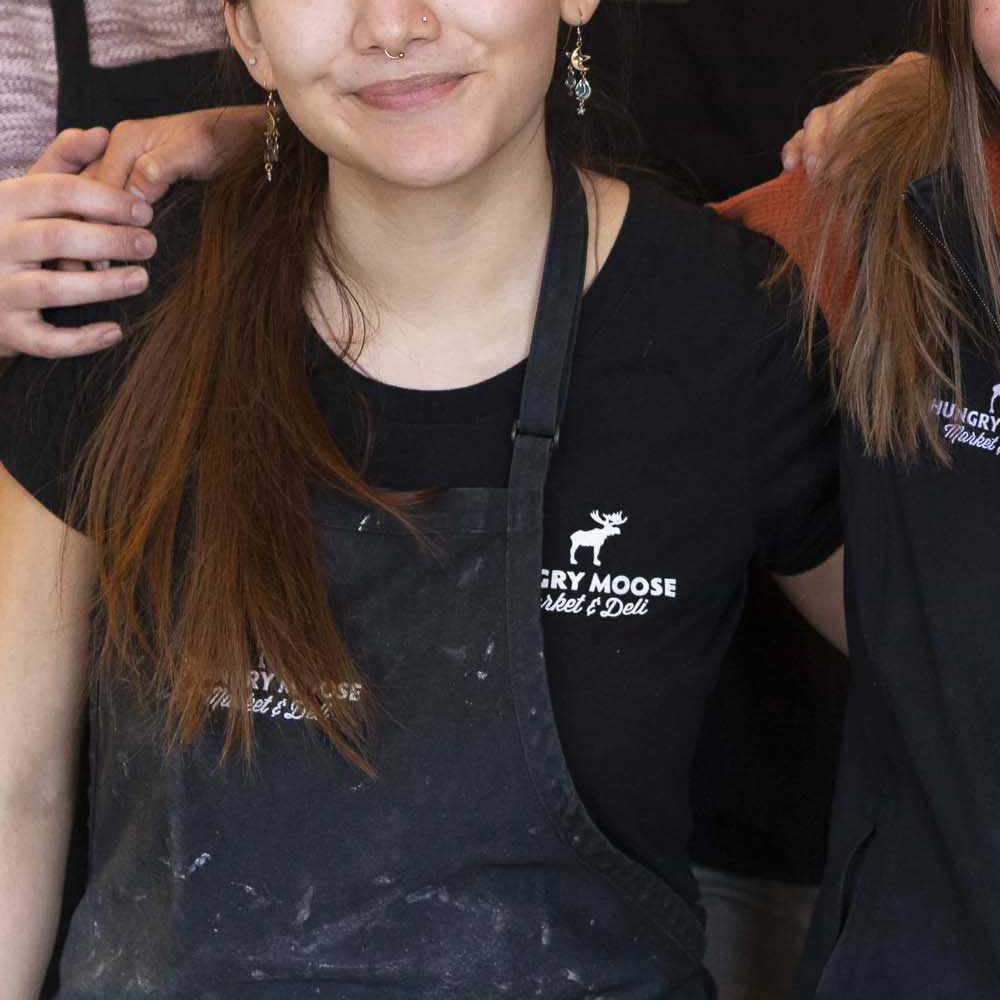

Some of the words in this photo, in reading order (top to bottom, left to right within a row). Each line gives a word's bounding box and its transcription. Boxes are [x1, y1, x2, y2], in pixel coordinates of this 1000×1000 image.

[944, 423, 999, 451] Market
[588, 572, 676, 598] MOOSE
[540, 592, 587, 613] rket
[586, 596, 601, 617] &
[599, 597, 648, 617] Deli
[270, 698, 287, 717] &
